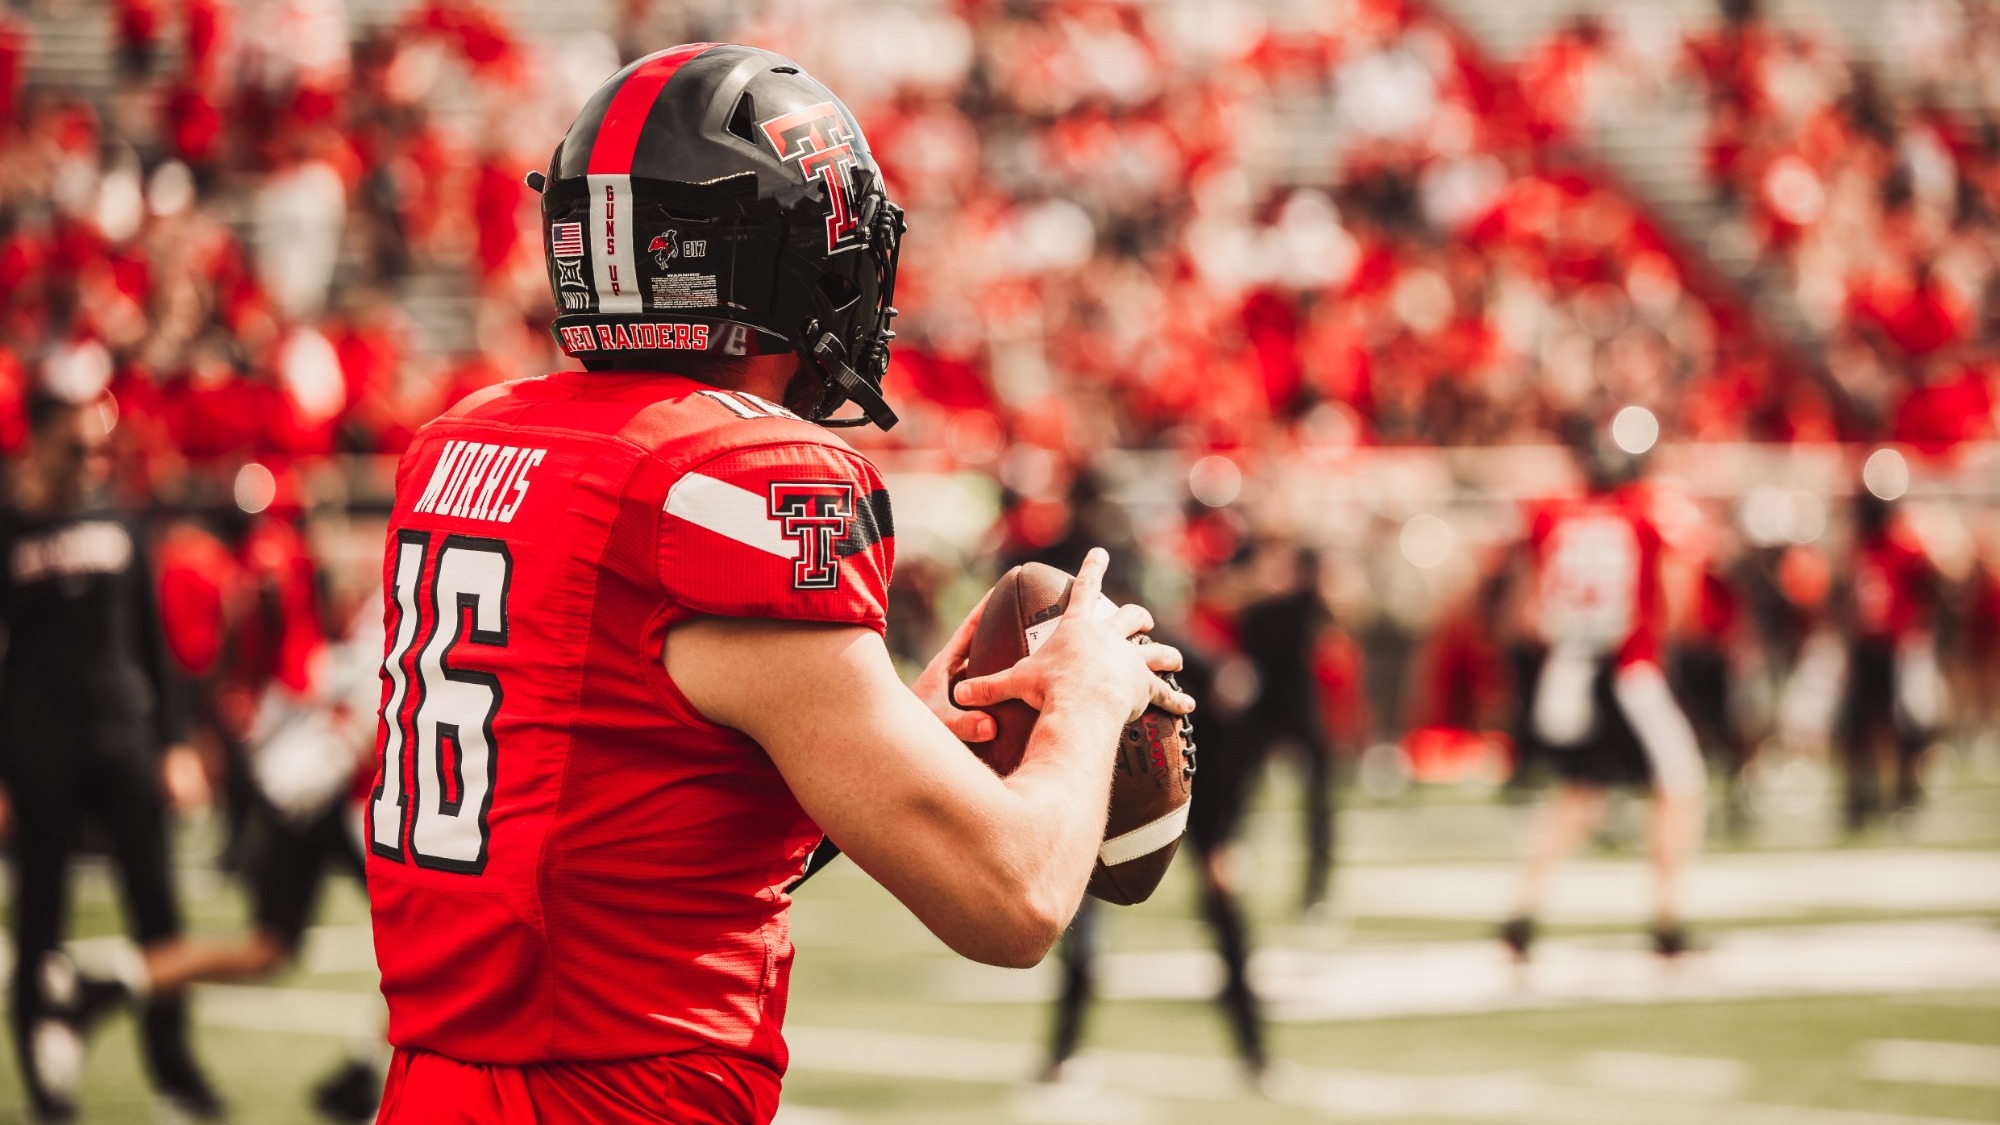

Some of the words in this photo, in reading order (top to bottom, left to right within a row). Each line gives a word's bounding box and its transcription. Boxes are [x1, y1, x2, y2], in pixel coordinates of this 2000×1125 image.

[605, 185, 615, 255] GUNS
[683, 240, 707, 258] 817
[608, 265, 621, 297] UP
[562, 291, 590, 309] UNITY
[559, 325, 597, 353] RED
[596, 323, 709, 351] RAIDERS
[414, 440, 546, 524] MORRIS
[370, 529, 514, 876] 16
